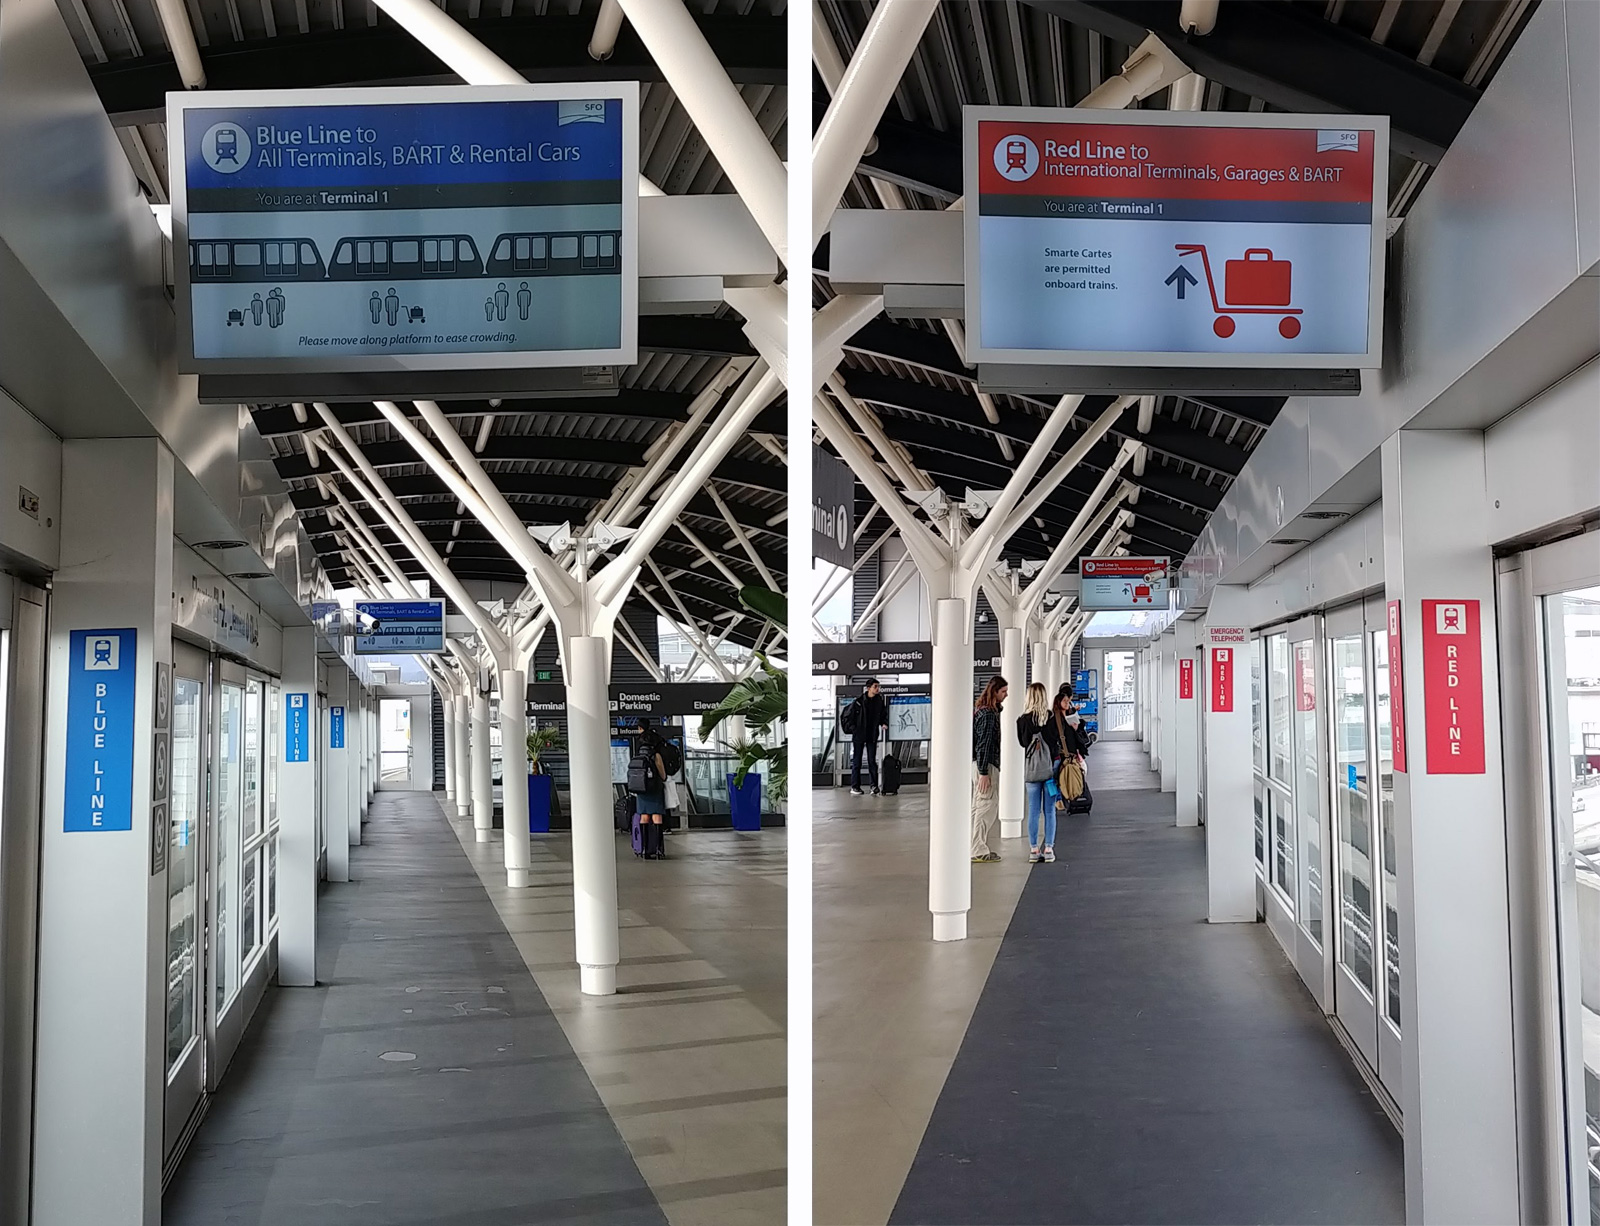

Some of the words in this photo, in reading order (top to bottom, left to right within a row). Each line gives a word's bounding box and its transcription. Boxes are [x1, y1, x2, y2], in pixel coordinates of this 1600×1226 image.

[584, 103, 603, 111] SFO
[256, 126, 303, 144] Blue
[307, 125, 351, 144] Line
[356, 127, 377, 144] to
[256, 147, 282, 168] All
[286, 146, 387, 168] Terminals,
[392, 145, 445, 165] BART
[449, 145, 465, 164] &
[469, 142, 532, 164] Rental
[538, 142, 581, 162] Cars
[1045, 140, 1080, 158] Red
[1086, 141, 1125, 159] Line
[1130, 143, 1149, 160] to
[1044, 161, 1142, 178] International
[1144, 163, 1220, 182] Terminals,
[1224, 166, 1284, 184] Garages
[1288, 167, 1300, 182] &
[1303, 168, 1343, 183] BART
[258, 193, 279, 206] You
[282, 195, 300, 205] are
[302, 194, 317, 204] at
[320, 191, 378, 204] Terminal
[382, 191, 389, 202] 1
[1044, 201, 1064, 213] You
[1066, 204, 1084, 213] are
[1086, 203, 1098, 213] at
[1101, 202, 1154, 214] Terminal
[1158, 203, 1163, 214] 1
[1045, 248, 1079, 258] Smarte
[1082, 248, 1112, 258] Cartes
[1062, 264, 1110, 276] permitted
[1045, 280, 1085, 290] onboard
[1088, 280, 1118, 290] trains.
[299, 335, 329, 346] Please
[331, 337, 358, 346] move
[360, 334, 387, 347] along
[389, 333, 431, 346] platform
[433, 334, 444, 344] to
[446, 335, 467, 343] ease
[469, 331, 518, 345] crowding.
[881, 651, 922, 659] Domestic
[881, 660, 913, 669] Parking
[1447, 645, 1458, 687] RED
[619, 693, 660, 702] Domestic
[530, 702, 565, 710] Terminal
[620, 702, 651, 711] Parking
[94, 683, 106, 748] BLUE
[1450, 698, 1461, 755] LINE
[91, 760, 104, 826] LINE
